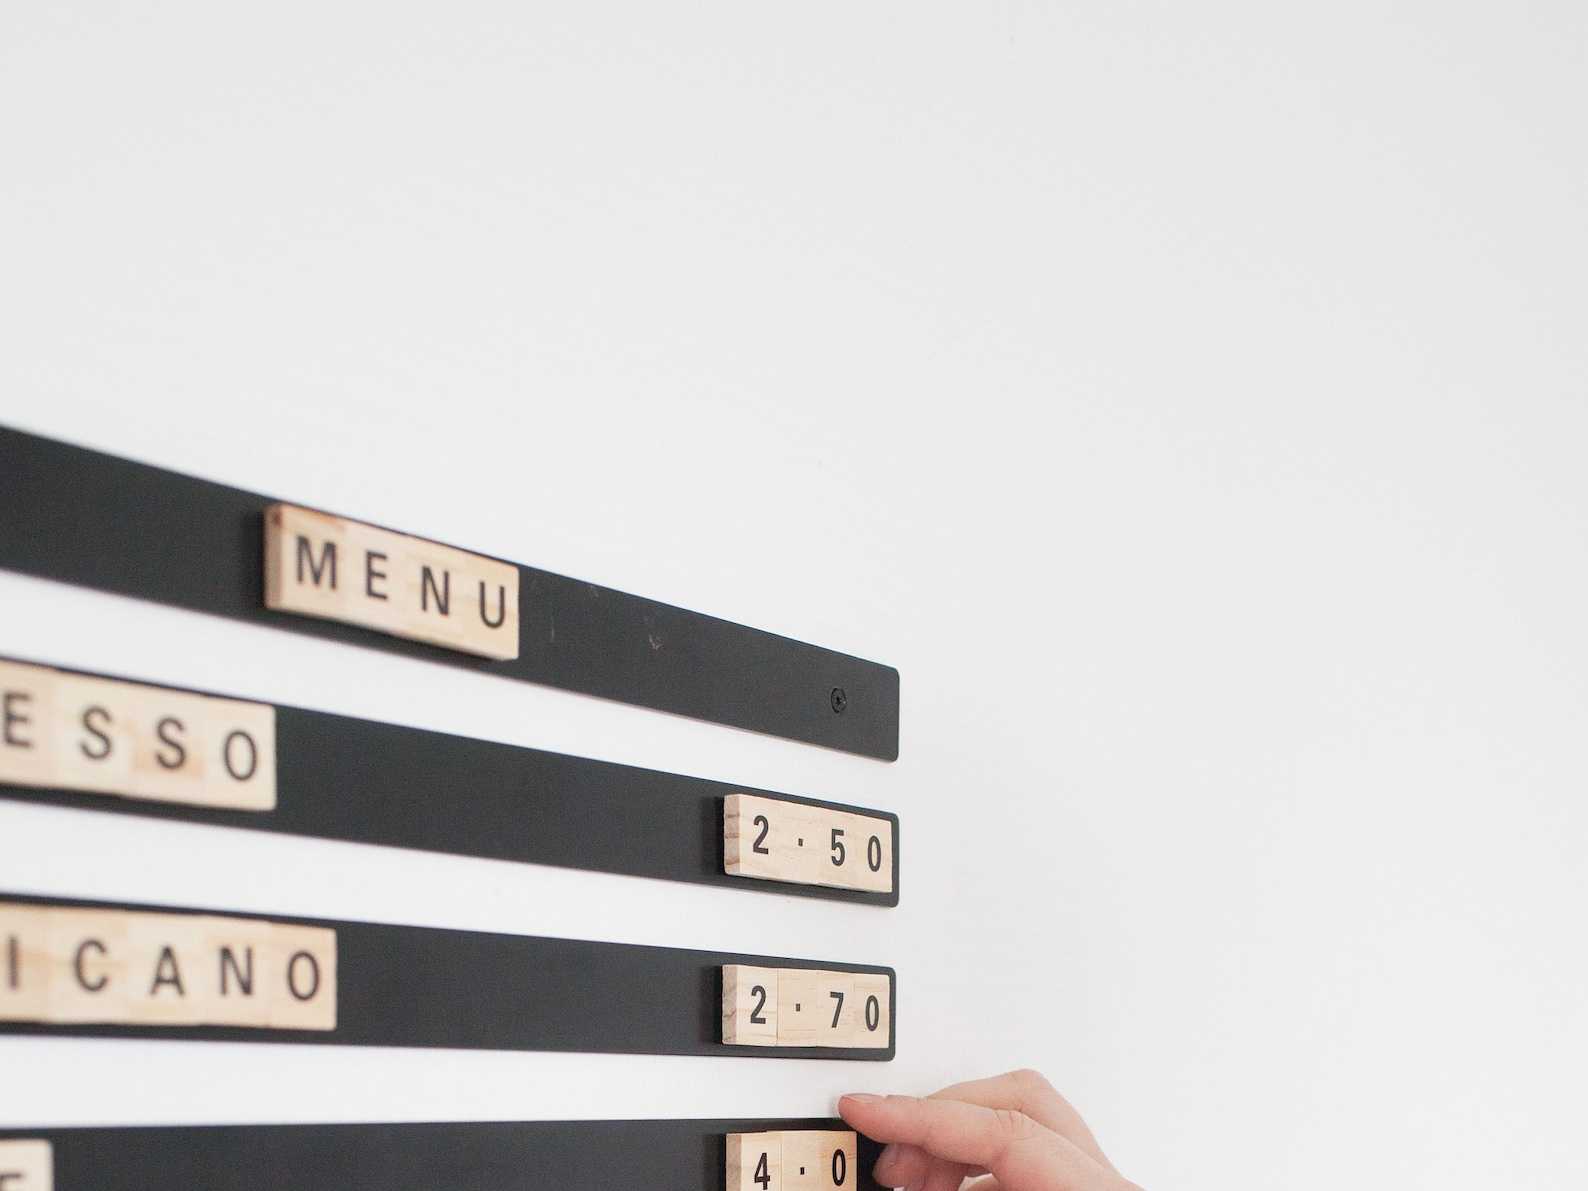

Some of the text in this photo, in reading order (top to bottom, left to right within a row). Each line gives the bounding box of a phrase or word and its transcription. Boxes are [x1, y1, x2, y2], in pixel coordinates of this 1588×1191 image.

[295, 535, 507, 629] MENU
[2, 691, 259, 781] ESSO
[6, 934, 321, 1002] ICANO
